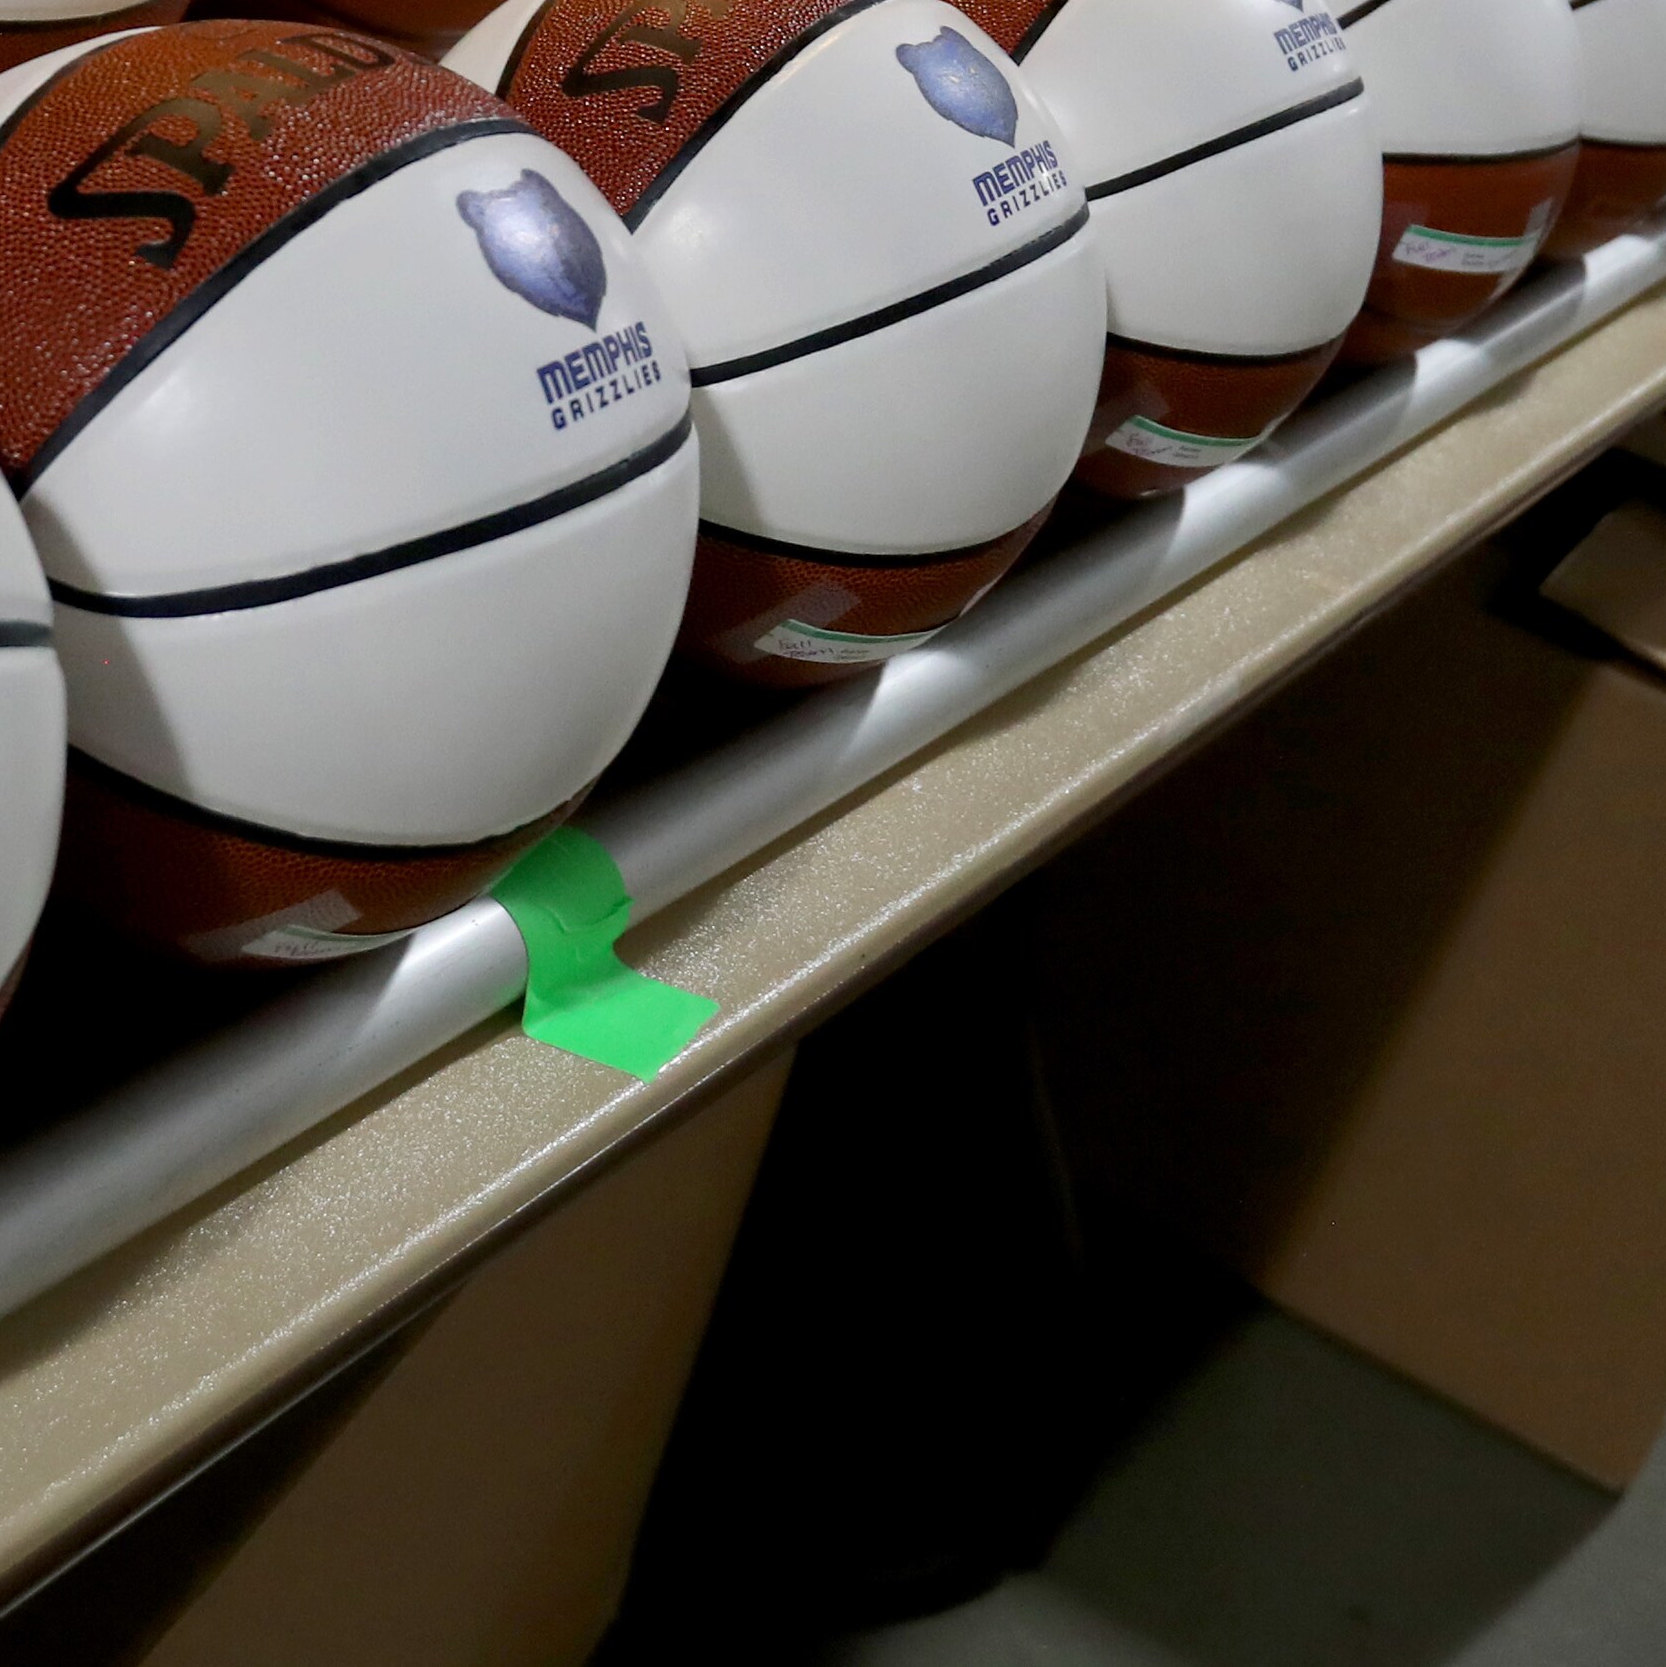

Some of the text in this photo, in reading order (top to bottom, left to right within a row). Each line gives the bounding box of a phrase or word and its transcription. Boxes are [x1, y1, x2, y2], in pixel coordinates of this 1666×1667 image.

[1274, 12, 1337, 55] MEMPHIS
[1287, 36, 1346, 71] GRIZZLIES
[973, 140, 1058, 206] MEMPHIS
[987, 170, 1068, 226] GRIZZLIES
[537, 321, 653, 404] MEMPHIS
[552, 361, 661, 430] GRIZZLIES
